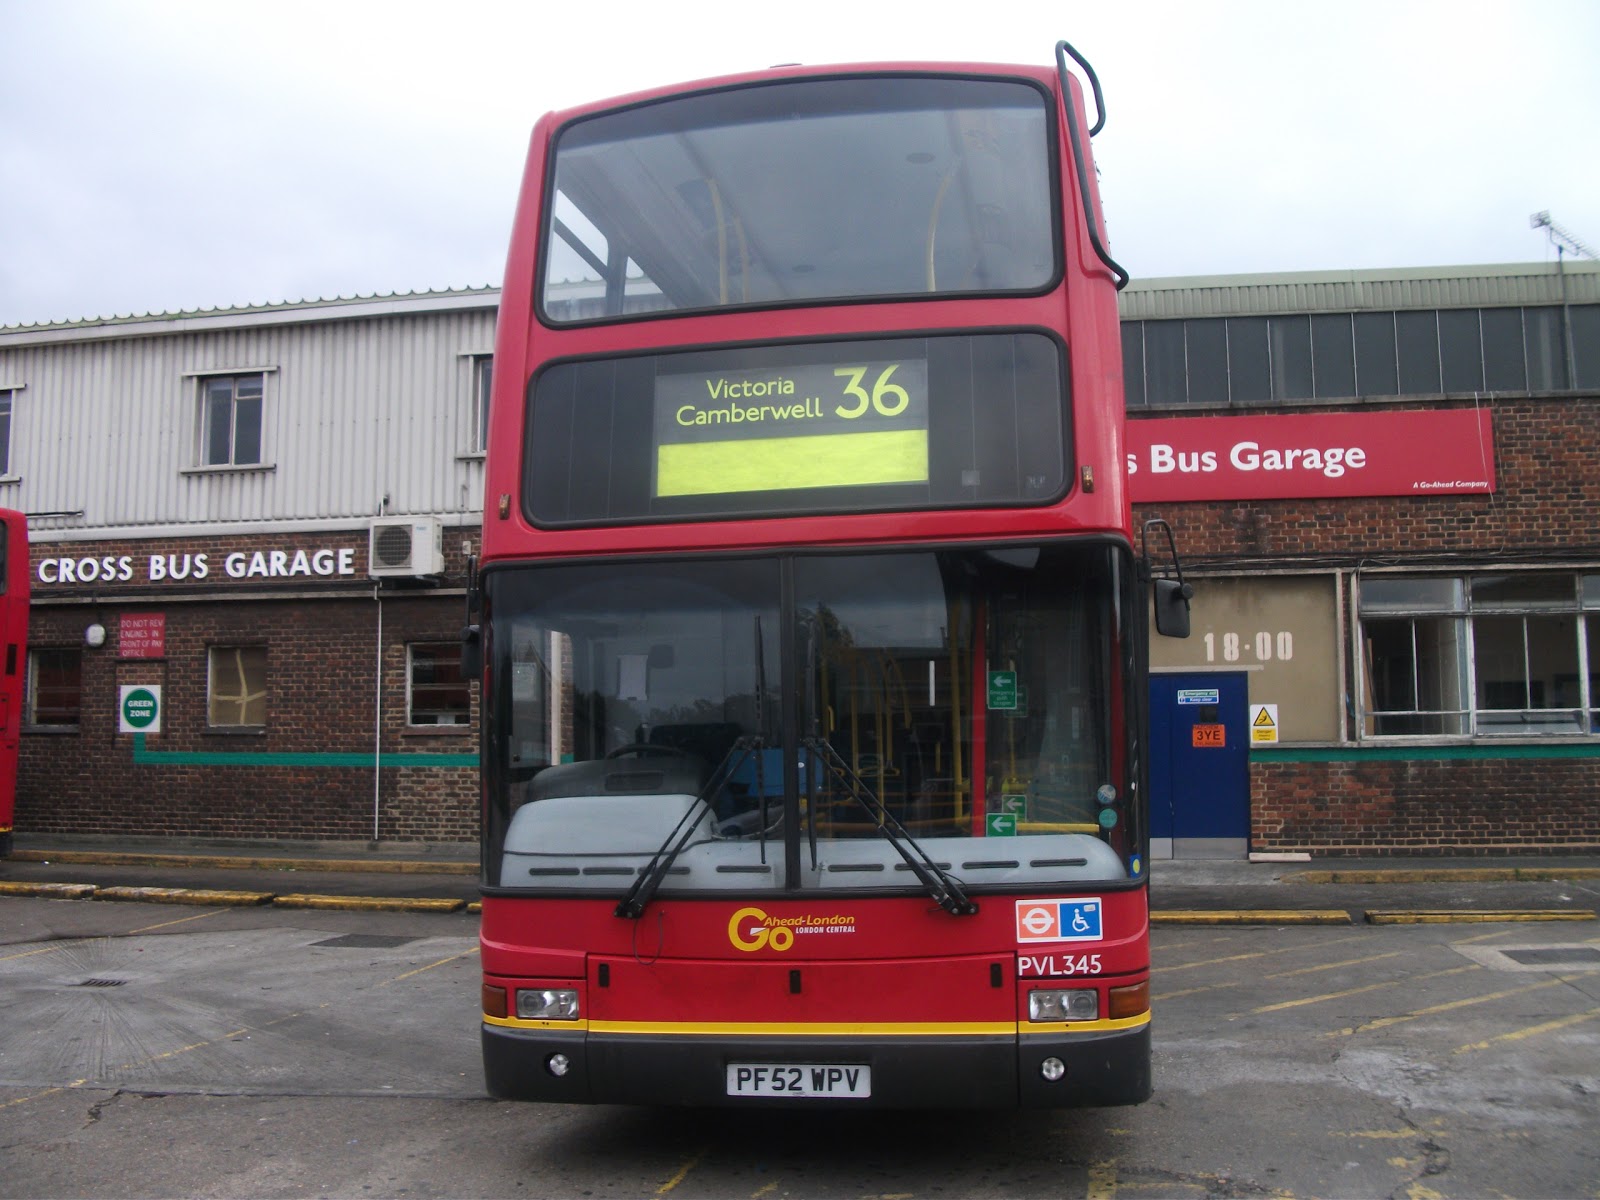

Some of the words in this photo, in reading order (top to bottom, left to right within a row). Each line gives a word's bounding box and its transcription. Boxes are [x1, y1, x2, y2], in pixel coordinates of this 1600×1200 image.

[706, 377, 795, 400] Victoria
[833, 364, 909, 419] 36
[676, 397, 823, 426] Camberwell
[1150, 444, 1218, 473] Bus
[1229, 441, 1366, 478] Garage
[38, 555, 134, 584] CROSS
[149, 553, 209, 581] BUS
[225, 548, 355, 578] GARAGE
[120, 629, 148, 638] ENGINES
[121, 620, 131, 628] DO
[132, 619, 148, 628] NOT
[149, 619, 162, 627] REV
[120, 640, 141, 648] FRONT
[122, 649, 145, 657] OFFICE
[1196, 730, 1221, 741] 3YE
[728, 907, 794, 952] Go
[795, 926, 824, 934] LONDON
[826, 925, 856, 933] CENTRAL
[1018, 954, 1102, 976] PVL345
[736, 1067, 803, 1091] PF52
[811, 1068, 860, 1092] WPV
